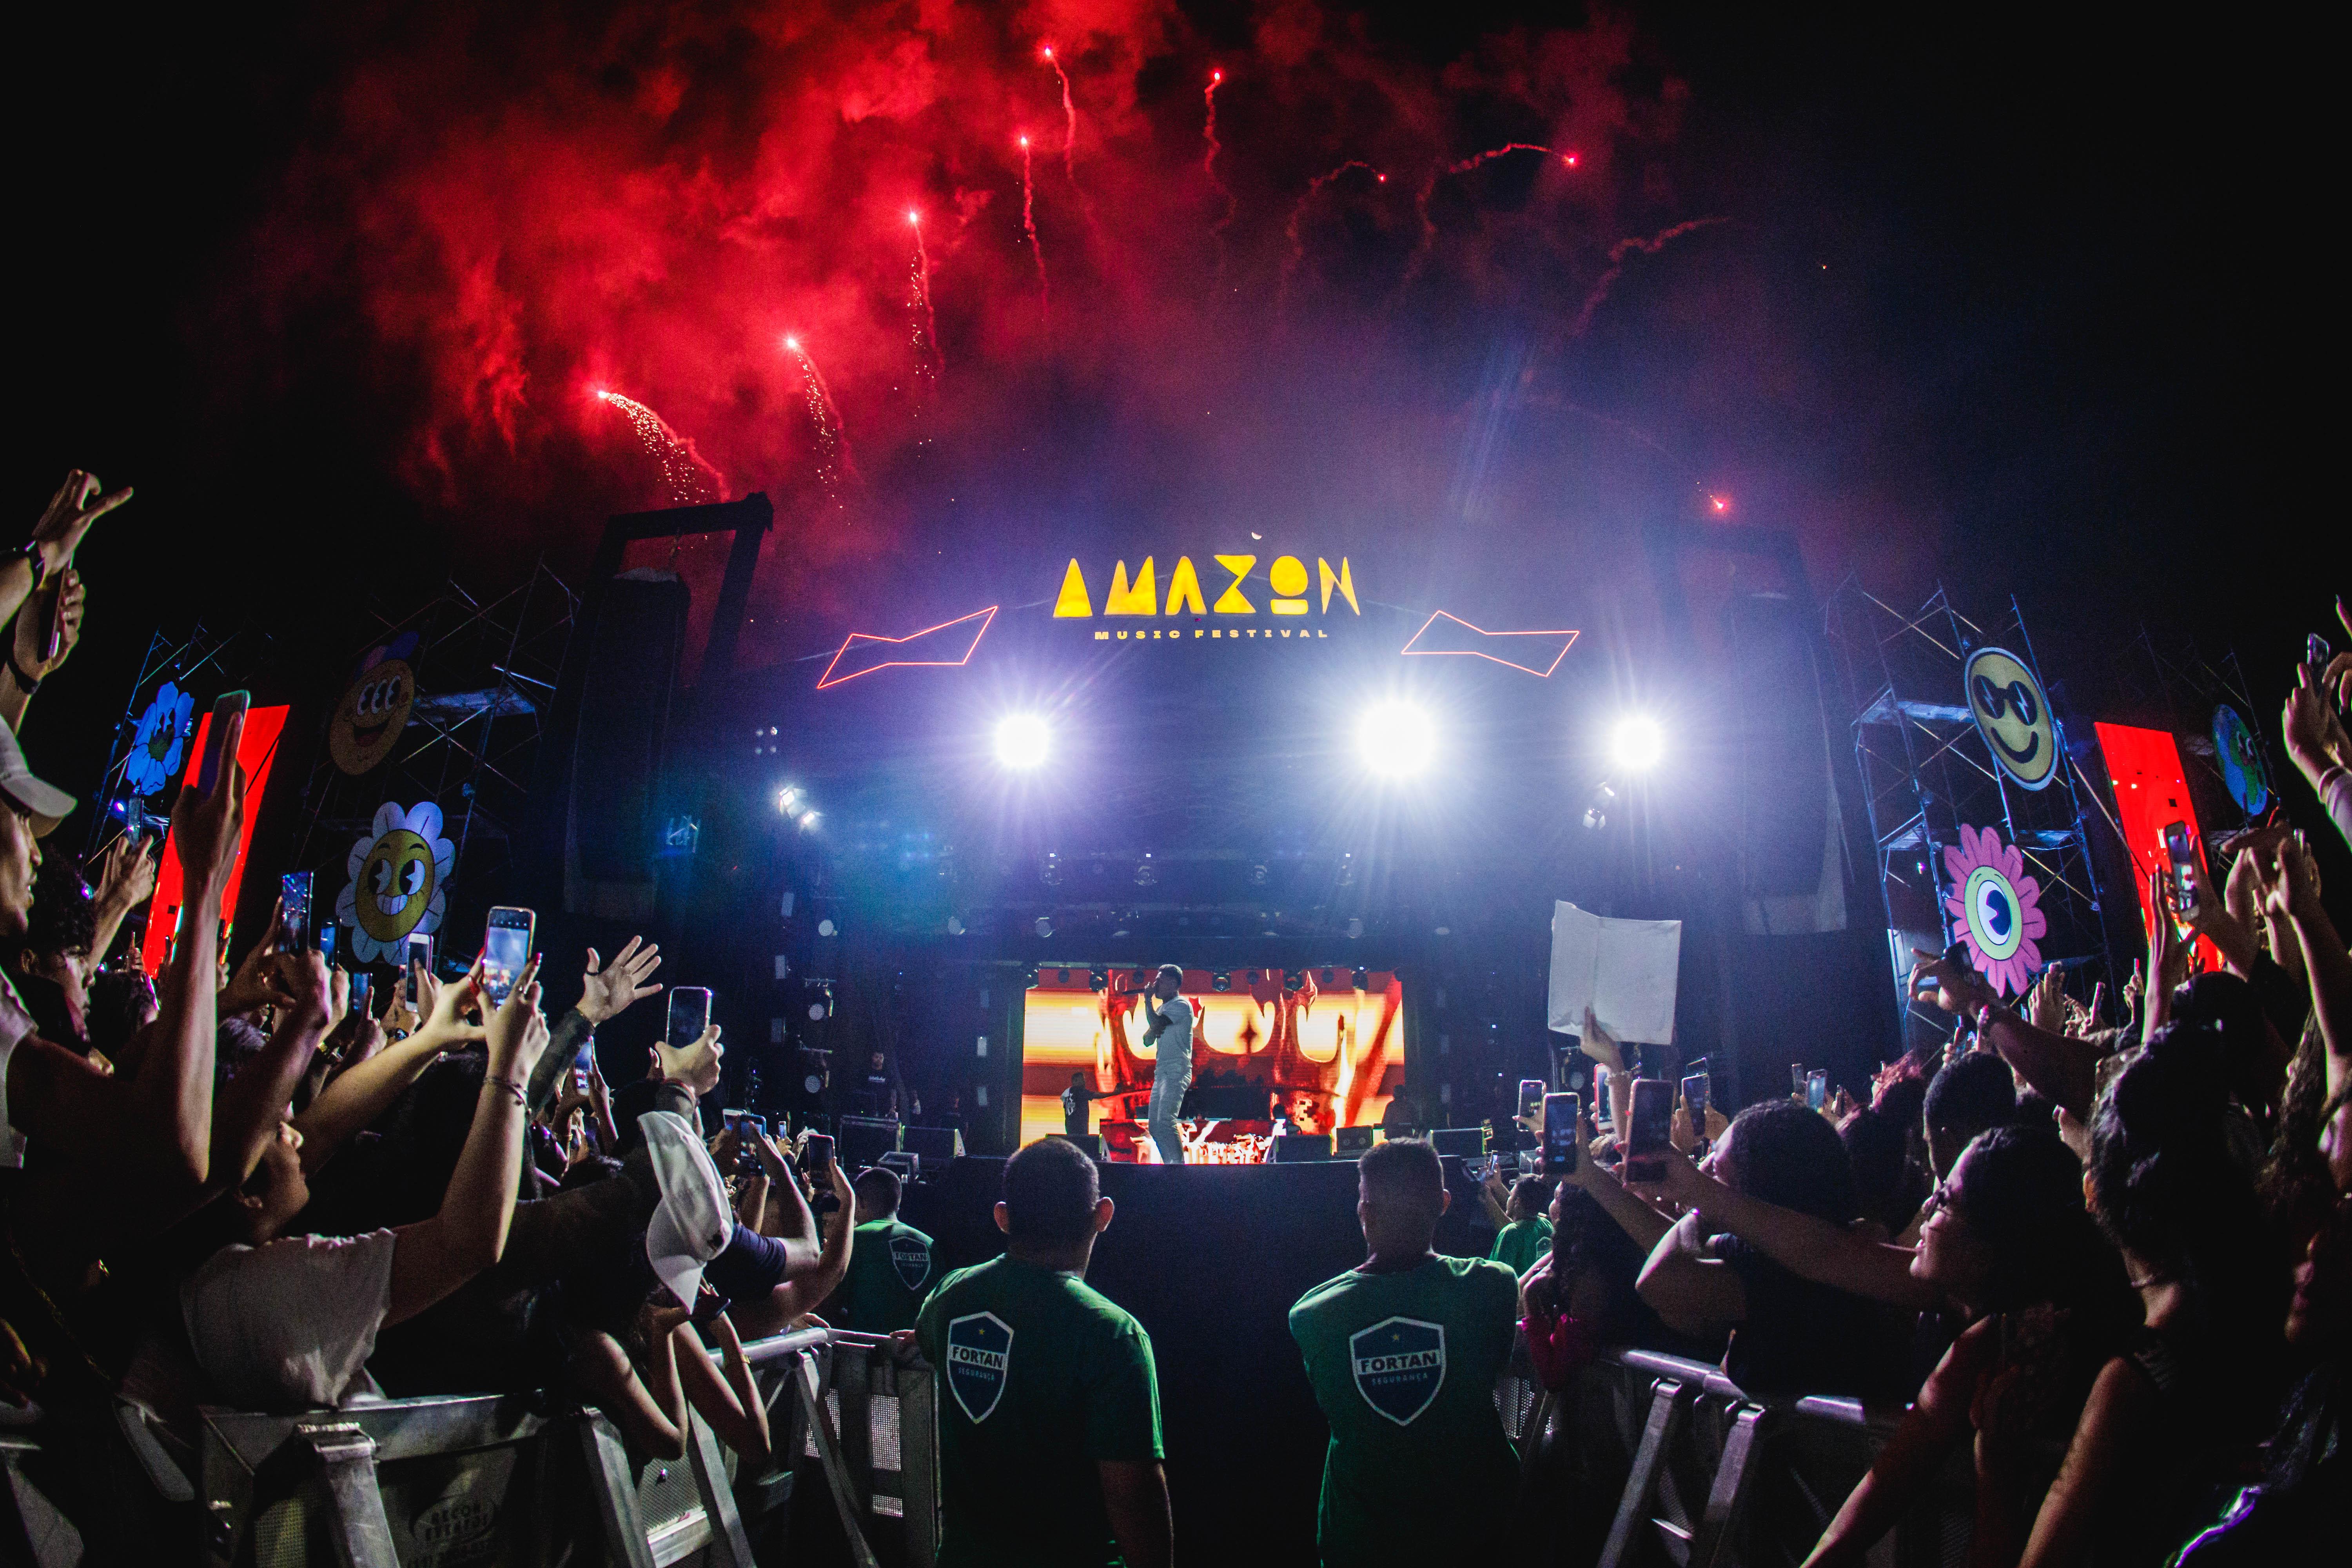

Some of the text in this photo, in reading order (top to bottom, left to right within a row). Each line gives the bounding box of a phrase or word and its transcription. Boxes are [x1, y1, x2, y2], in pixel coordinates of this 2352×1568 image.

[1053, 554, 1361, 618] AMAZON
[1094, 629, 1328, 640] MUSIC FESTIVAL
[953, 1346, 1004, 1368] FORTAN
[1361, 1352, 1437, 1372] FORTAN
